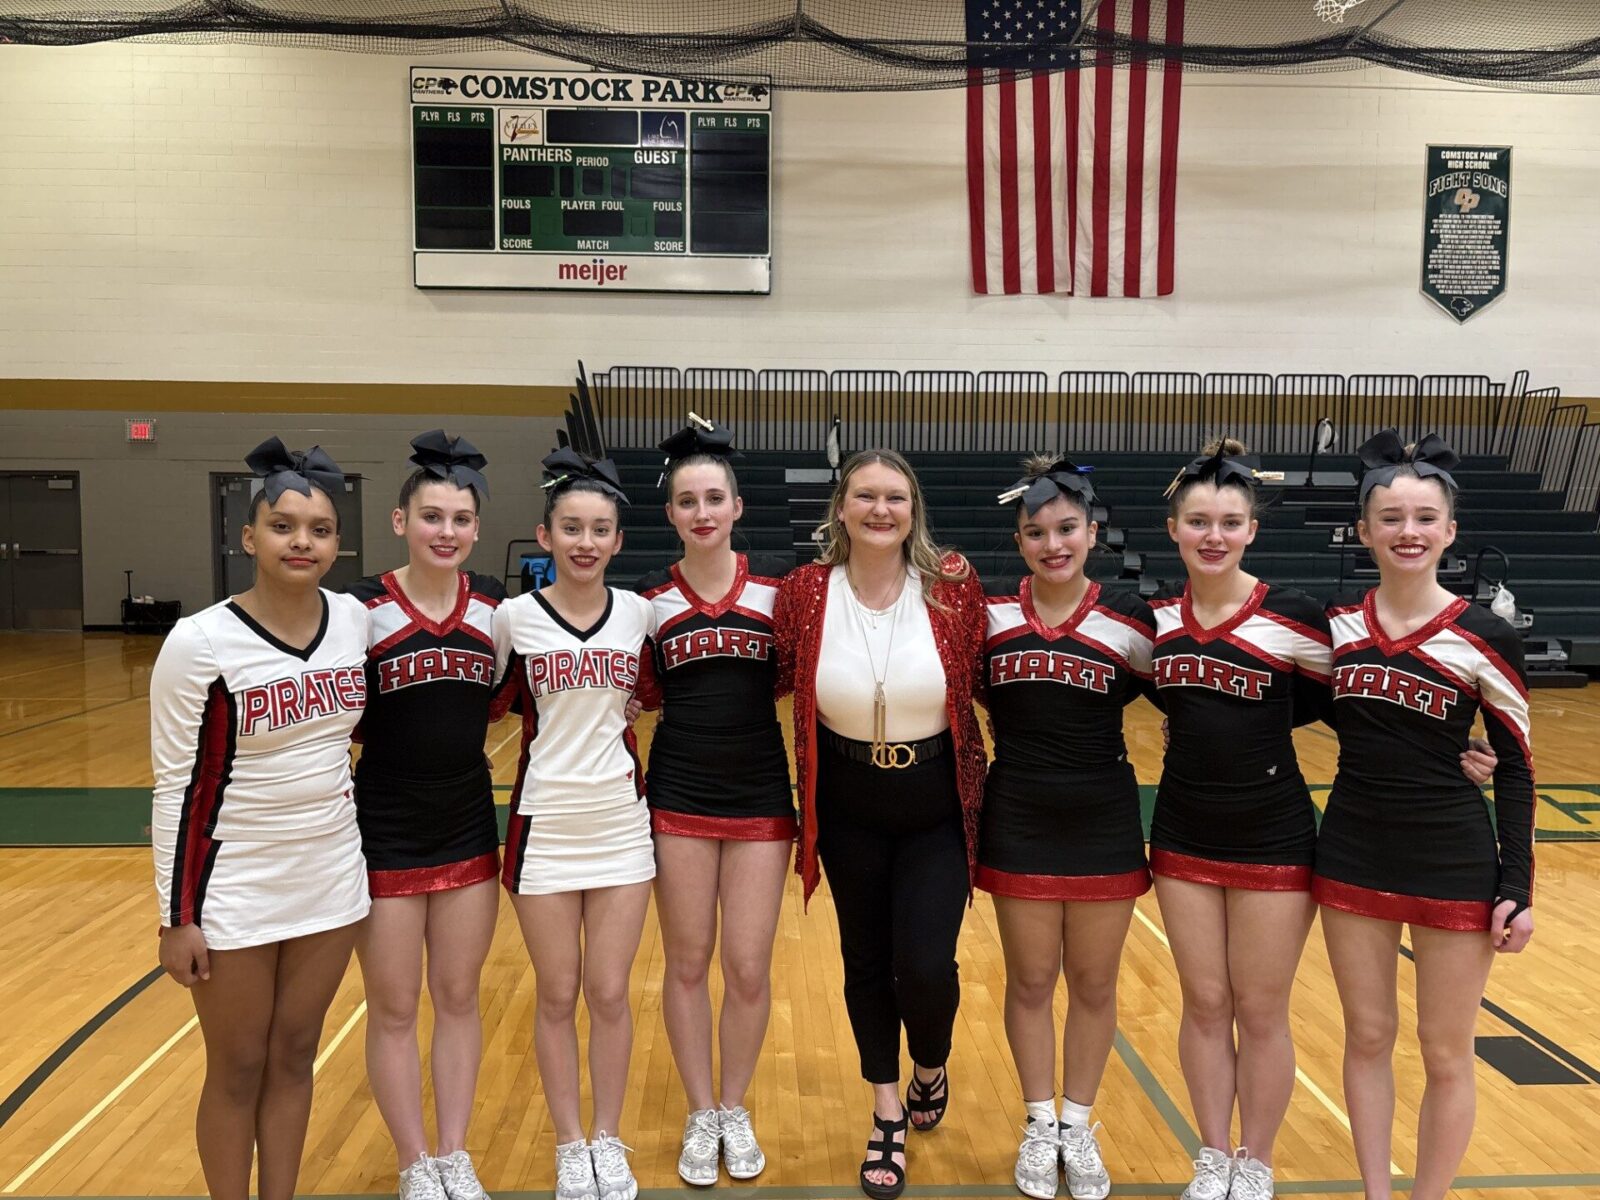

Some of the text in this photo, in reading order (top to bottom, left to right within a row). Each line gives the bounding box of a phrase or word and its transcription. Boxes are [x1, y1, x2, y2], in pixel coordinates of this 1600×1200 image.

[459, 75, 724, 103] COMSTOCK PARK
[420, 111, 485, 122] PLYR FLS PTS
[697, 117, 761, 128] PLYR FLS PTS
[503, 147, 573, 163] PANTHERS
[576, 156, 609, 167] PERIOD
[634, 150, 678, 165] GUEST
[1440, 150, 1498, 160] COMSTOCK PARK
[1447, 160, 1490, 170] HIGH SCHOOL
[1429, 171, 1507, 198] FIGHT SONG
[501, 199, 531, 210] FOULS
[560, 200, 625, 211] PLAYER FOUL
[653, 201, 683, 212] FOULS
[502, 239, 533, 249] SCORE
[577, 240, 609, 250] MATCH
[654, 241, 684, 251] SCORE
[558, 258, 628, 286] meijer
[662, 627, 773, 670] HART
[378, 647, 496, 694] HART
[530, 648, 639, 697] PIRATES
[990, 650, 1116, 694] HART
[1152, 653, 1272, 700] HART
[1332, 663, 1458, 720] HART
[240, 666, 368, 736] PIRATES
